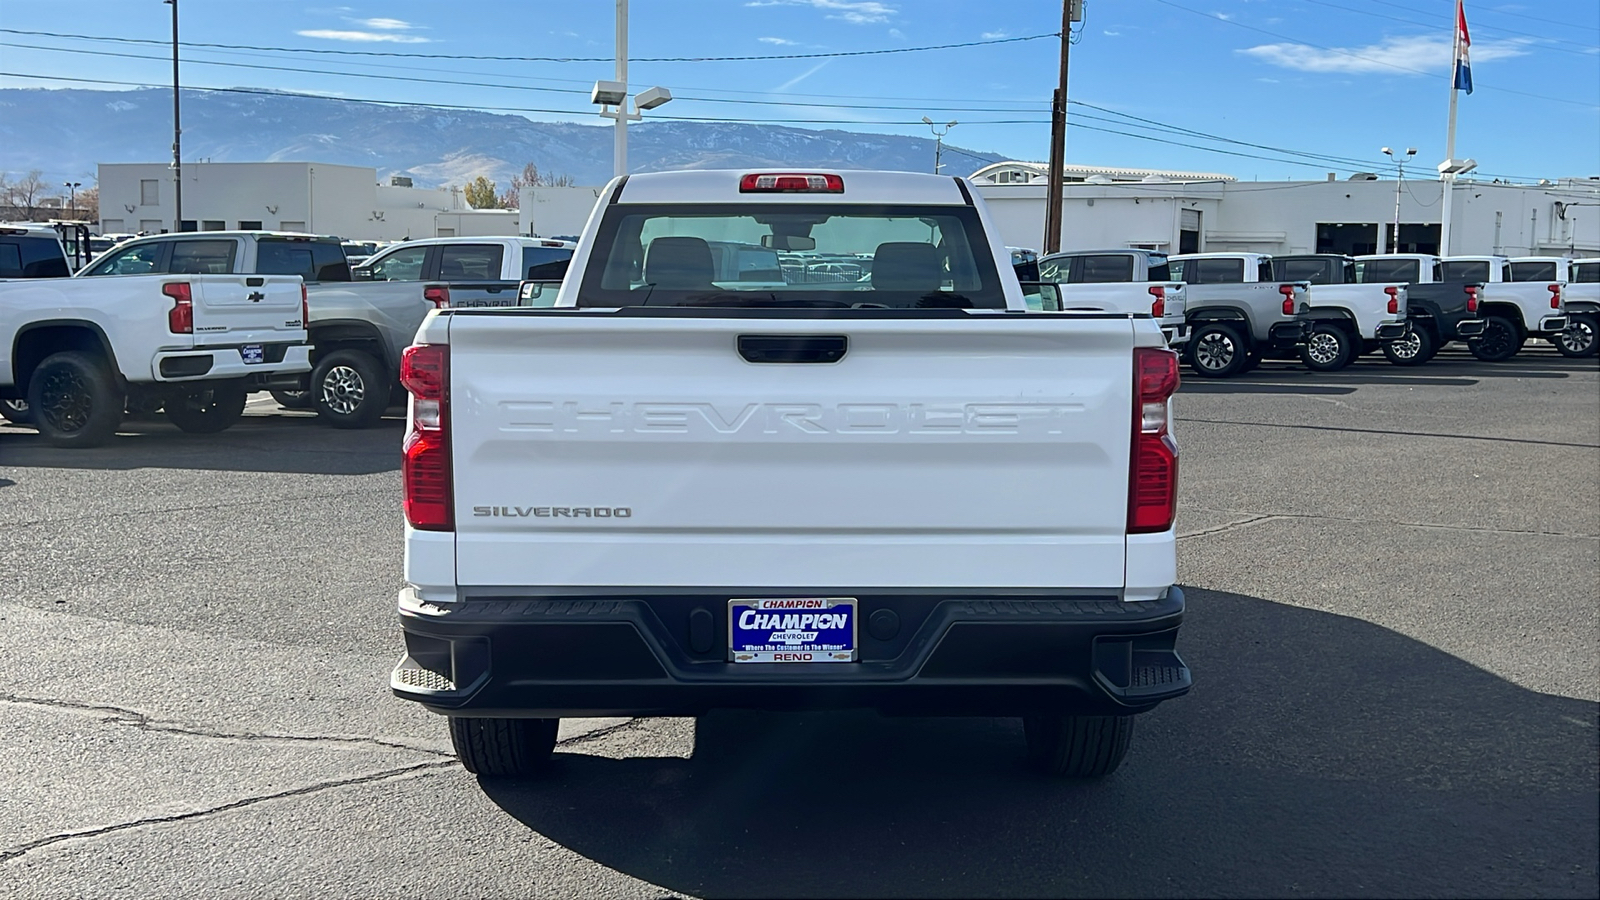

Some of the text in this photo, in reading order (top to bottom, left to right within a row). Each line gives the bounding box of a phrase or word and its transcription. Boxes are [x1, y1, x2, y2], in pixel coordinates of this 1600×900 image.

[498, 400, 1085, 434] CHEVROLET
[473, 506, 632, 518] SILVERADO
[763, 600, 823, 609] CHAMPION
[738, 610, 848, 630] CHAMPION
[773, 653, 813, 661] RENO
